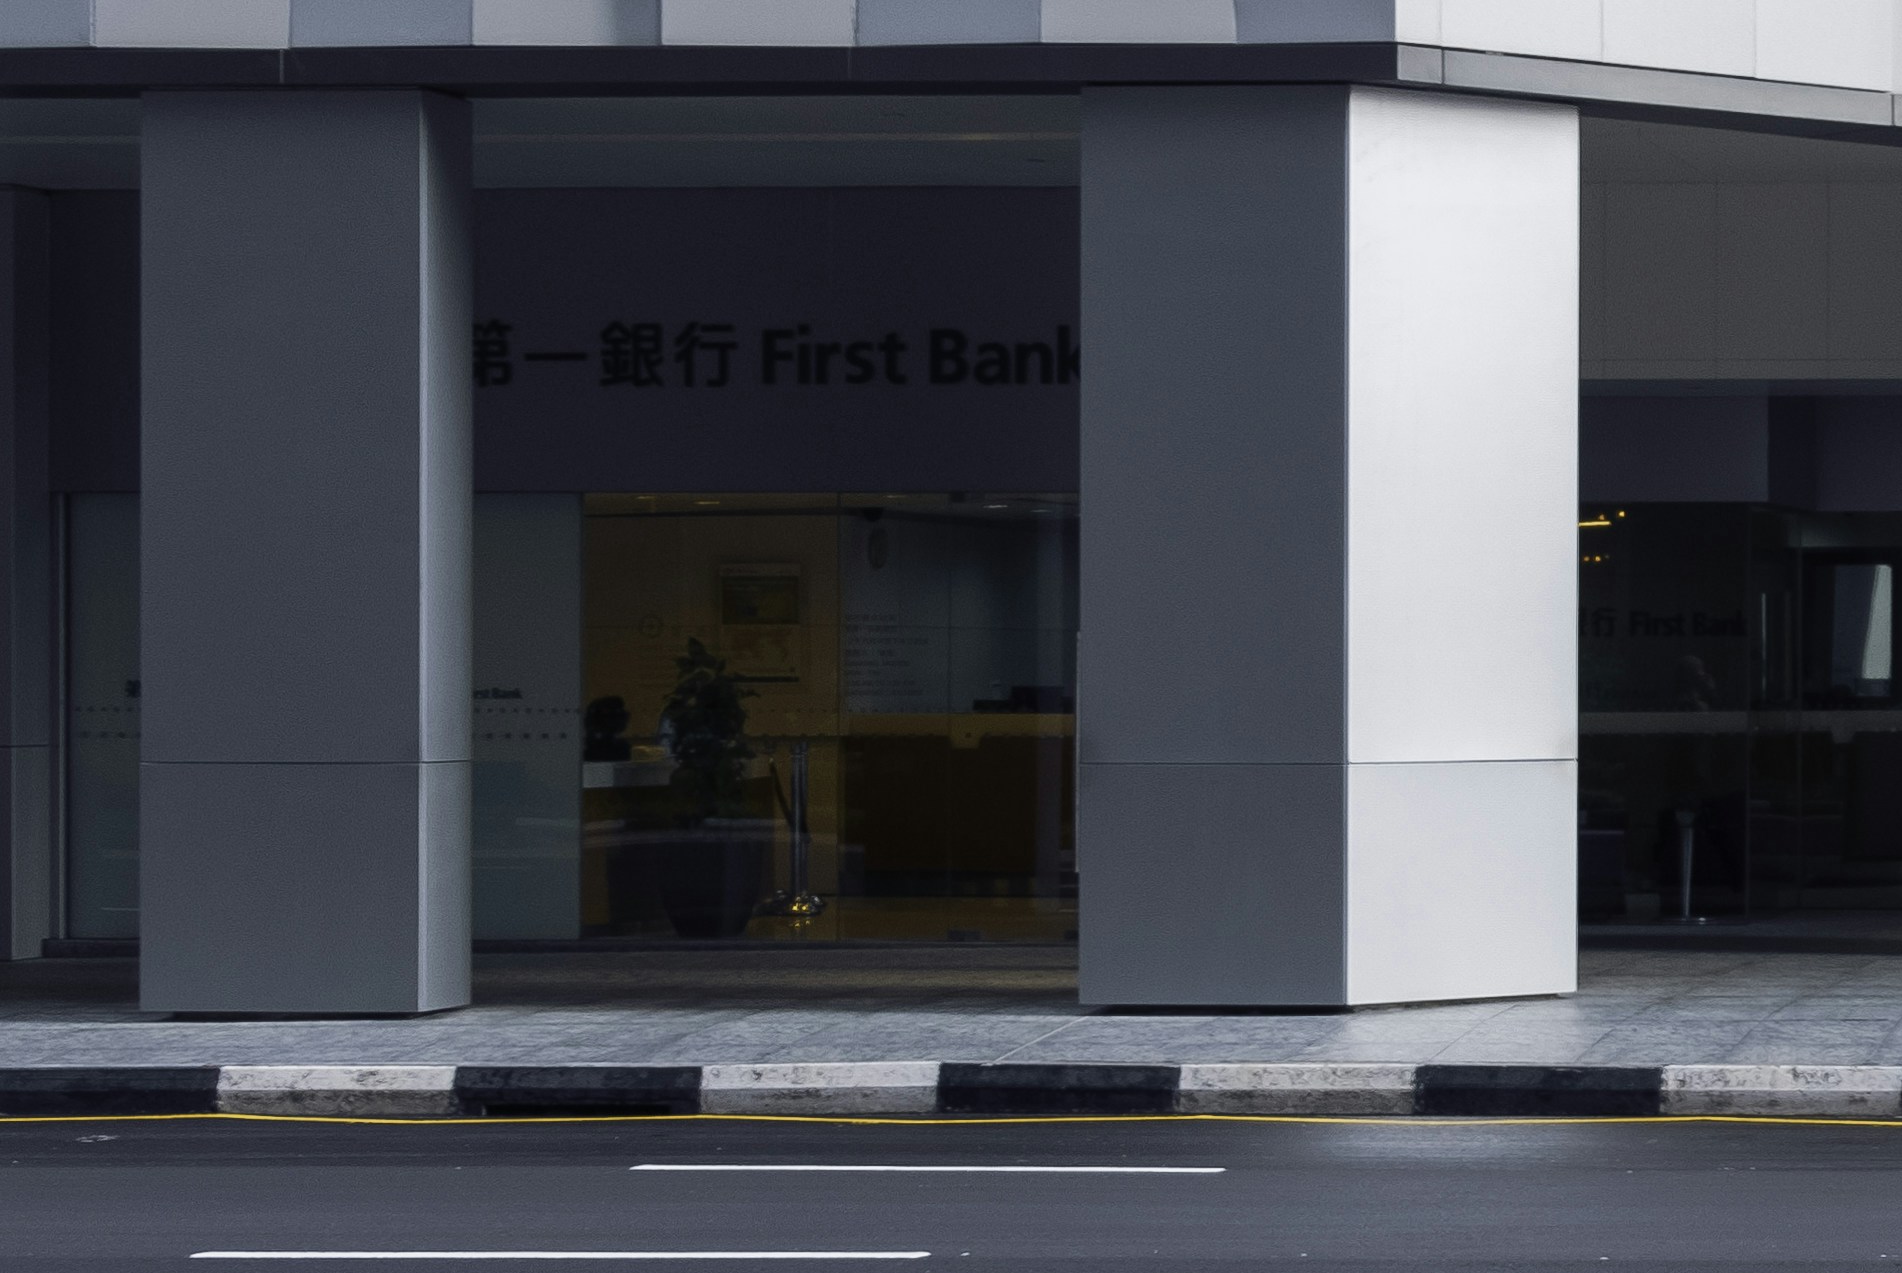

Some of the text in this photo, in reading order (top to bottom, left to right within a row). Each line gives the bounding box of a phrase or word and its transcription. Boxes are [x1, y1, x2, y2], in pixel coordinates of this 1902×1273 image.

[760, 324, 907, 387] First
[929, 324, 1081, 387] Bank
[1629, 609, 1686, 637] First
